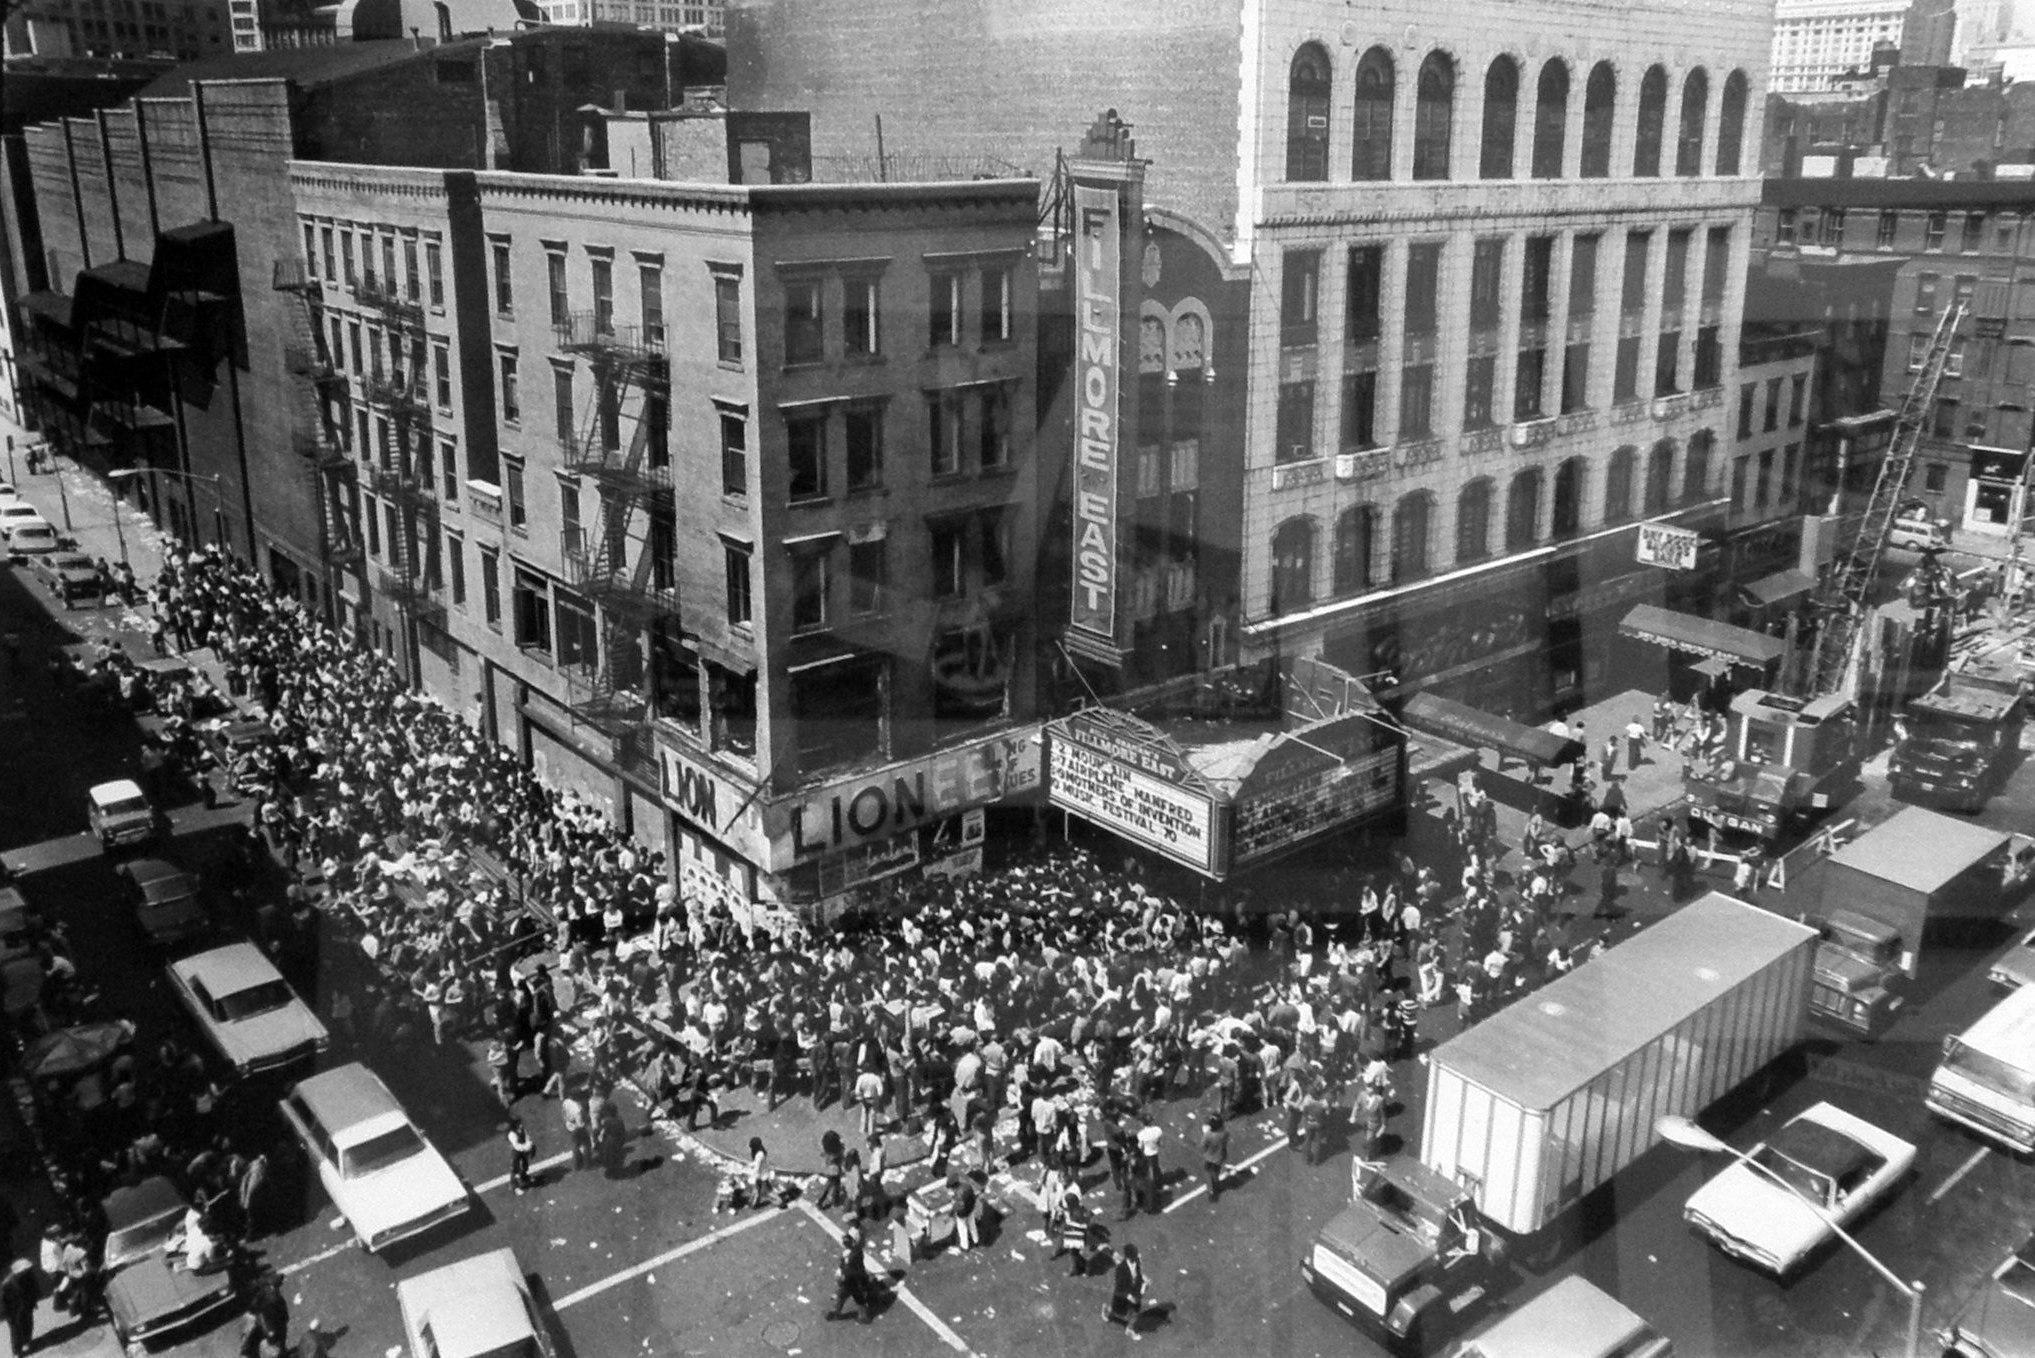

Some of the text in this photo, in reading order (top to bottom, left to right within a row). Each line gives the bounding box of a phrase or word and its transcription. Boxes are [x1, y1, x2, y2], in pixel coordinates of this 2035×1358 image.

[1079, 207, 1112, 610] FILLMORE EAST
[1141, 755, 1175, 779] EAST
[660, 752, 717, 829] LION
[1134, 788, 1194, 823] MANFRED
[791, 771, 925, 857] LION
[1102, 800, 1156, 834] FESTIVAL
[1120, 794, 1134, 809] OF
[1138, 803, 1202, 839] INVENTION
